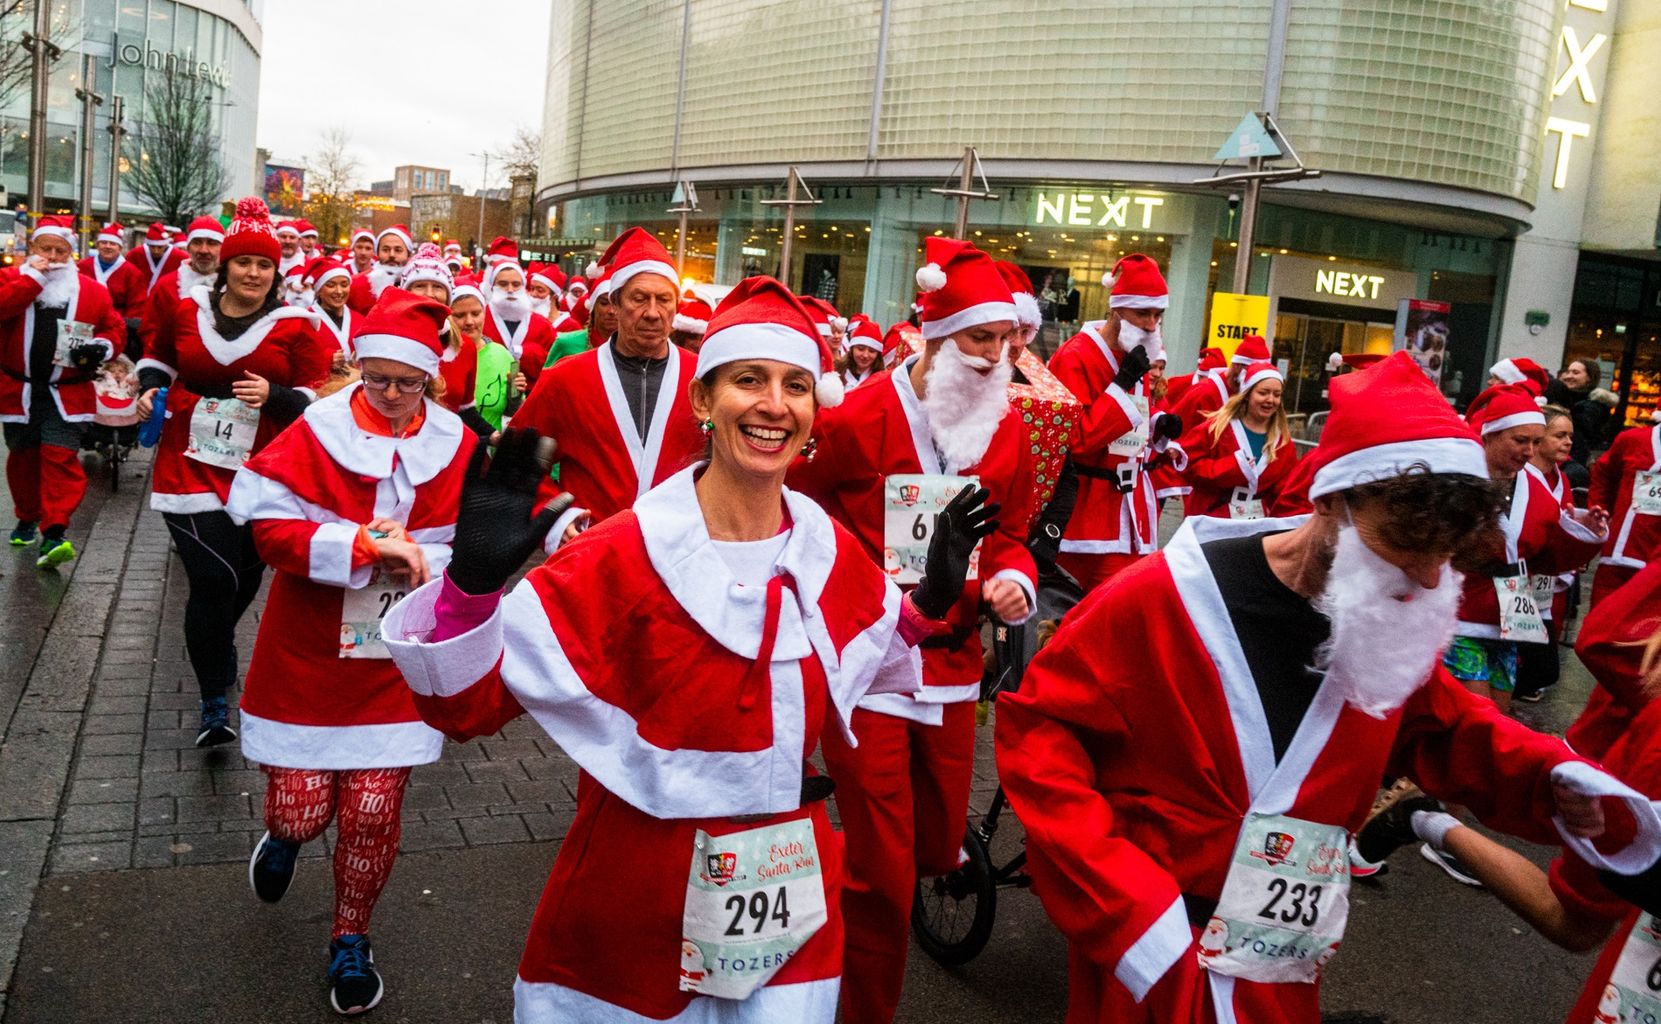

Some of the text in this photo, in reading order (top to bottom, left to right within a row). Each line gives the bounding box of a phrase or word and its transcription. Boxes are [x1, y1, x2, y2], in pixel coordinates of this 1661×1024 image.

[104, 31, 178, 74] John
[1036, 193, 1164, 229] NEXT
[1315, 269, 1384, 299] NEXT
[215, 420, 233, 440] 14
[1515, 596, 1535, 615] 286
[768, 841, 804, 862] Exeter
[757, 862, 792, 883] Santa
[724, 886, 791, 936] 294
[1258, 878, 1322, 927] 233
[1240, 937, 1309, 960] TOZERS
